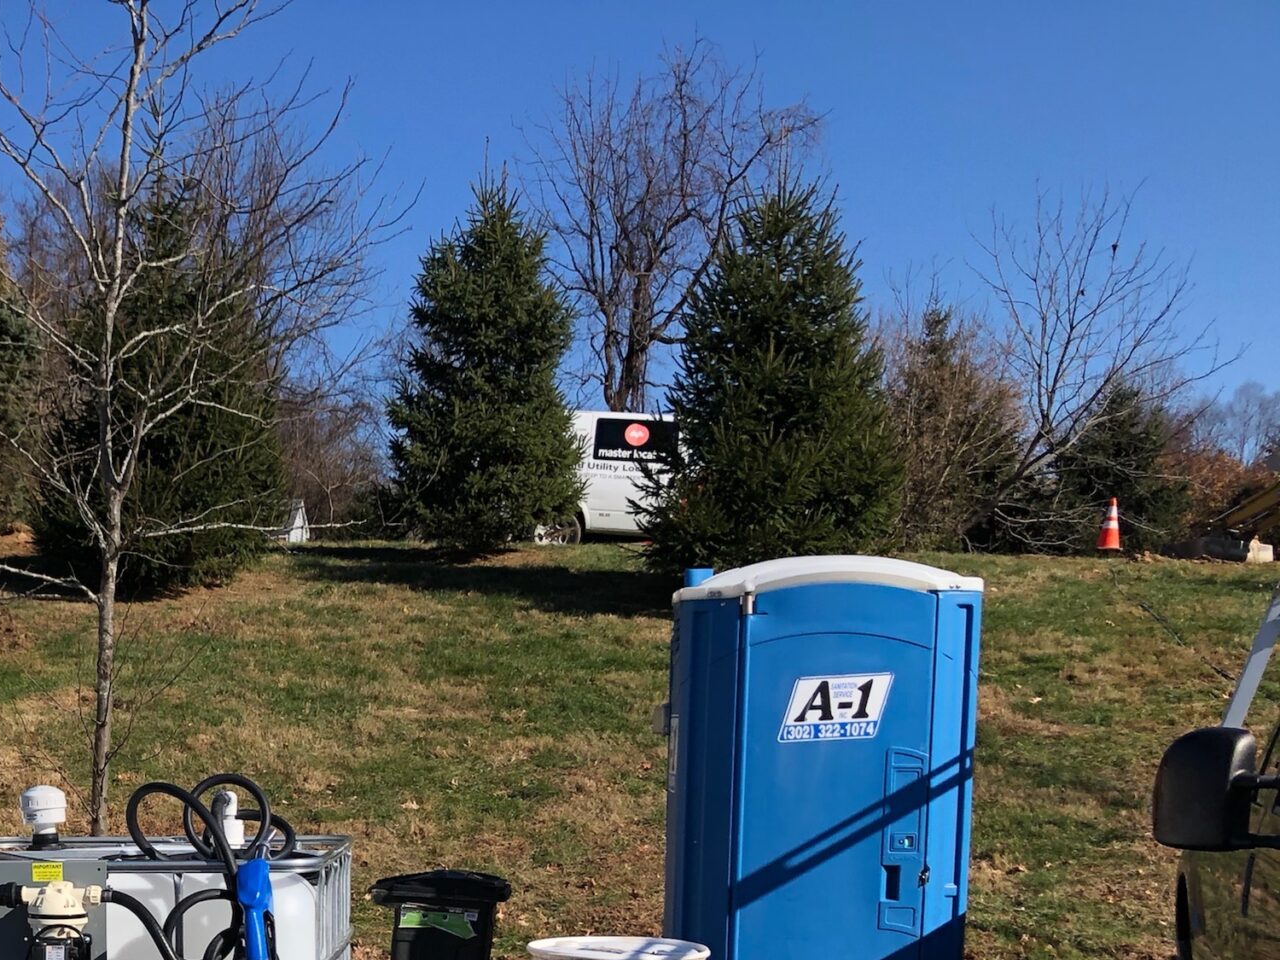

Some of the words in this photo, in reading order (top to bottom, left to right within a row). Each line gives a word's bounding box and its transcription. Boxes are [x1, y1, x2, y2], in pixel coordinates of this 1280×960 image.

[598, 448, 632, 458] master
[587, 462, 619, 473] Utility
[793, 679, 873, 722] A-1
[783, 725, 814, 739] (302)
[818, 722, 875, 738] 322-1074
